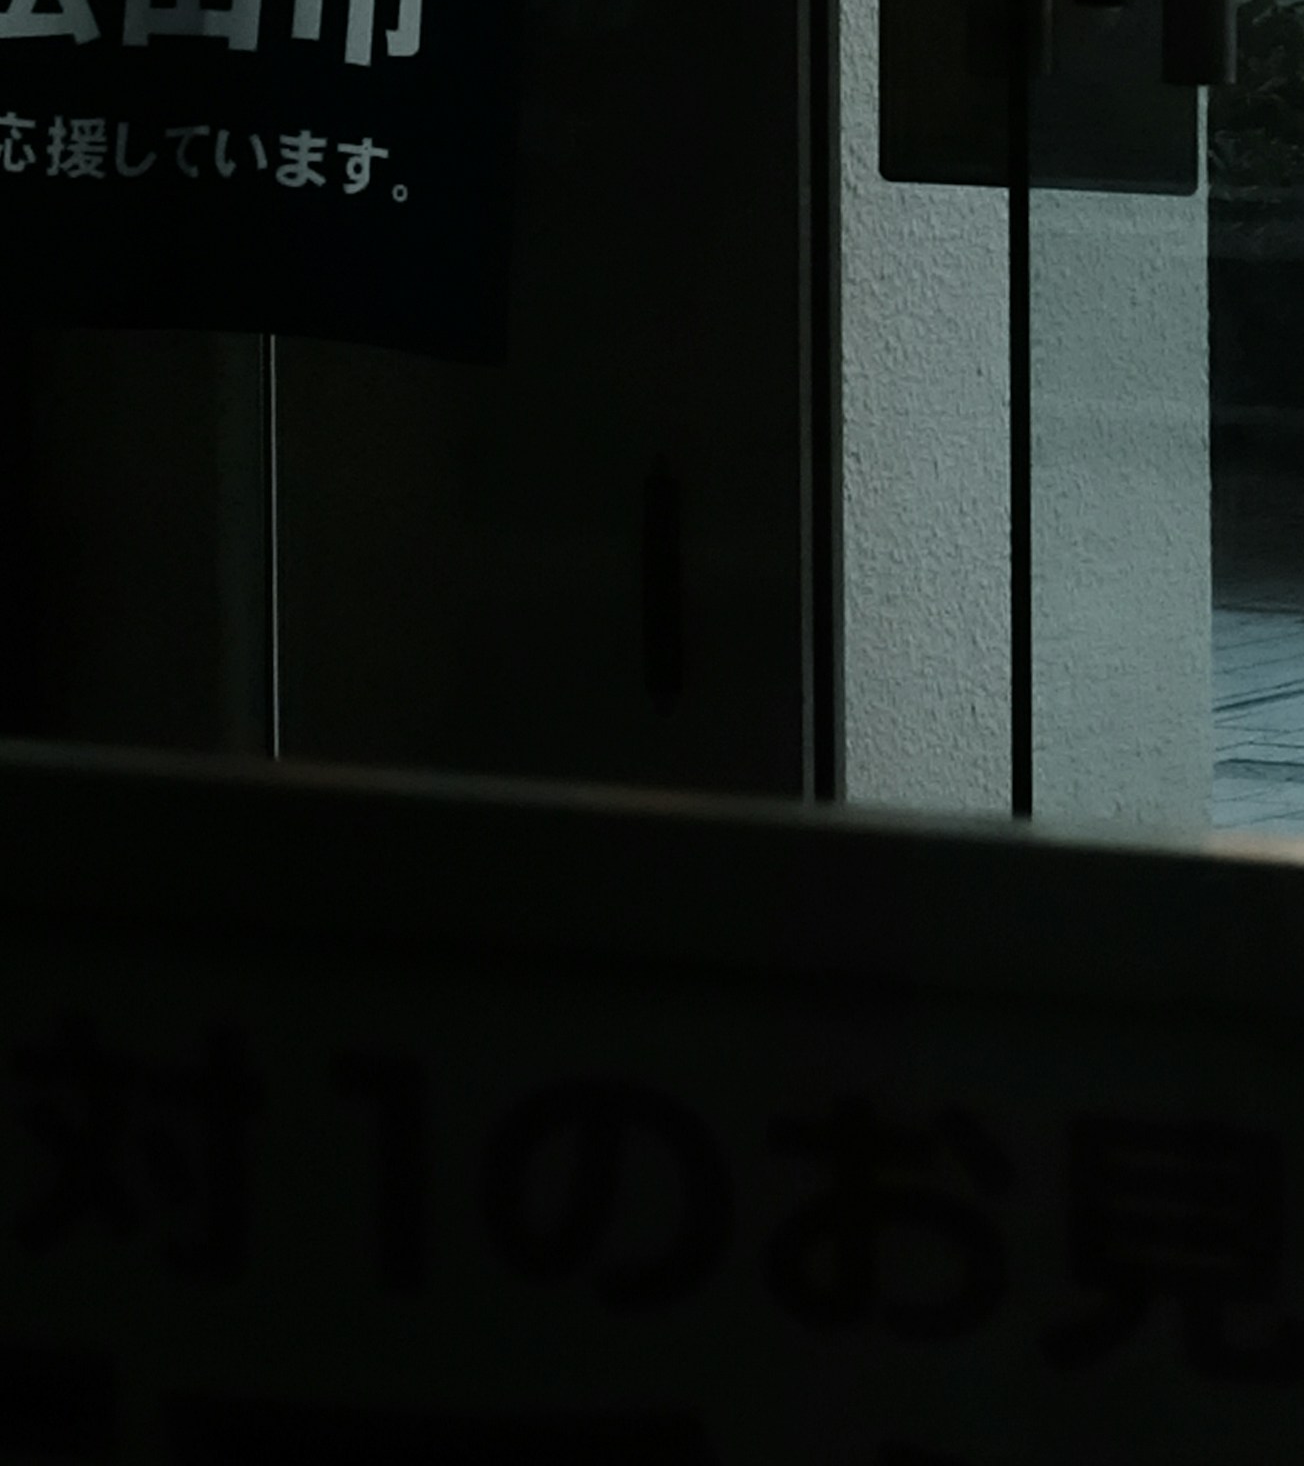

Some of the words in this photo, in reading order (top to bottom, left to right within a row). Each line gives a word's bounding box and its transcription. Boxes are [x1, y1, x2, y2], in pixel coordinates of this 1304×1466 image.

[0, 111, 408, 204] 応援しています。
